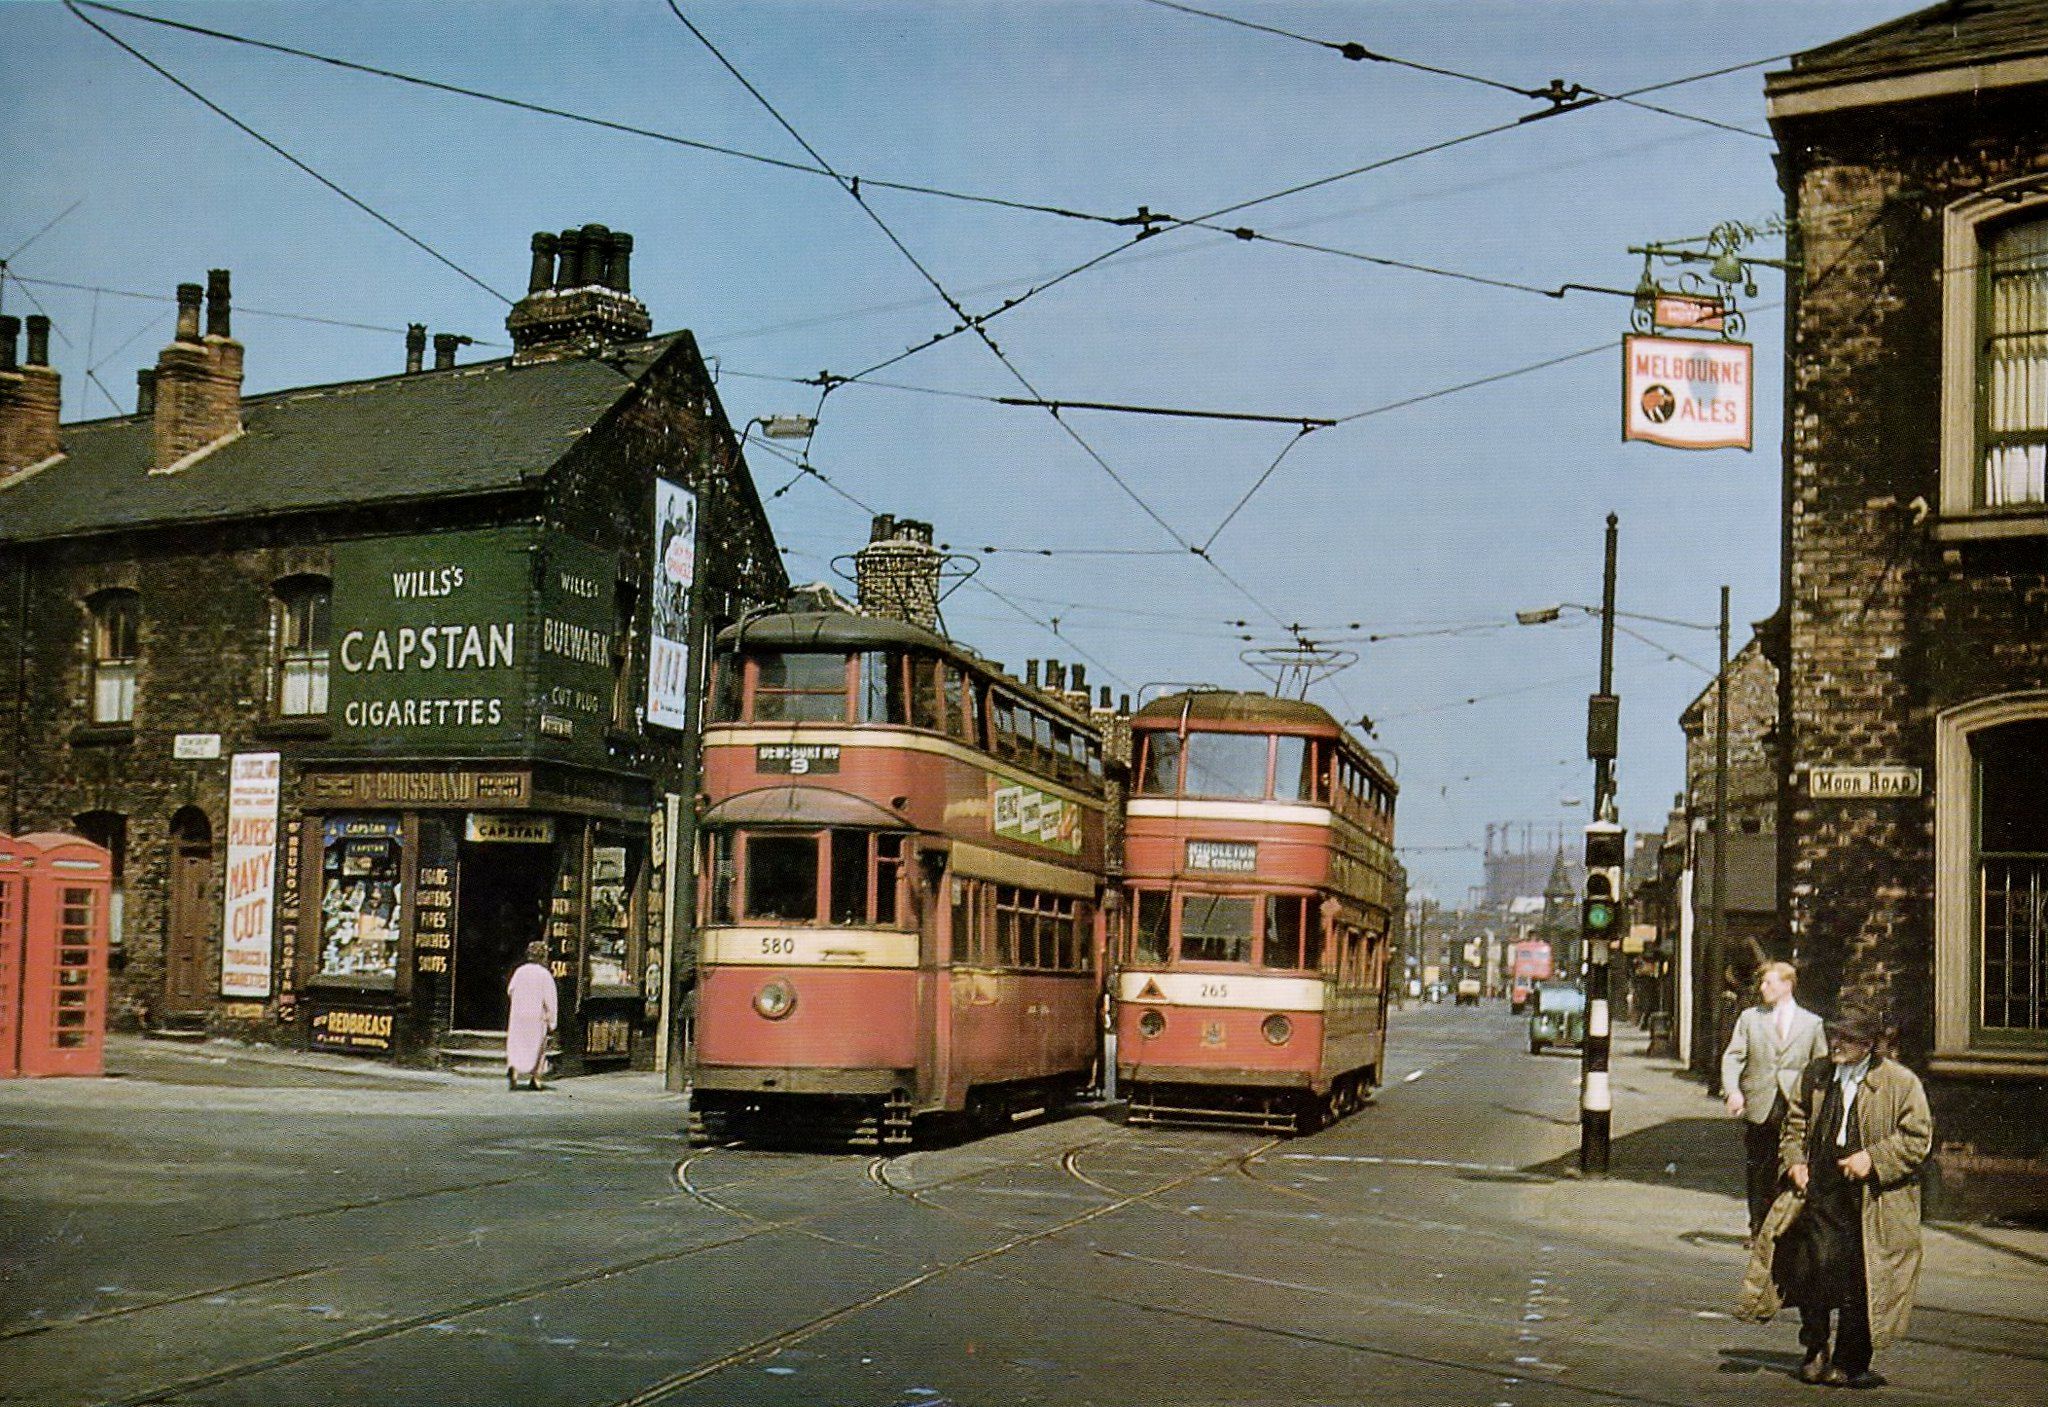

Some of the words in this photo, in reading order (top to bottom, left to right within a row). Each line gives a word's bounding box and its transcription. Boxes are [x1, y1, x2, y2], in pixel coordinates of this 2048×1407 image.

[1636, 353, 1742, 385] MELBOURNE
[1681, 397, 1737, 424] ALES
[340, 622, 514, 672] CAPSTAN
[543, 617, 610, 668] BULWARK
[345, 698, 502, 727] CIGARETTES
[790, 758, 809, 774] 9
[377, 772, 470, 800] CROSSLAND
[1819, 771, 1861, 791] MOOR
[1870, 770, 1911, 791] ROAD
[478, 825, 544, 839] CAPSTAN
[229, 849, 272, 901] NAVY
[233, 897, 267, 943] CUT
[761, 937, 795, 954] 580
[1201, 983, 1229, 998] 265
[328, 1011, 393, 1037] REDBREAST
